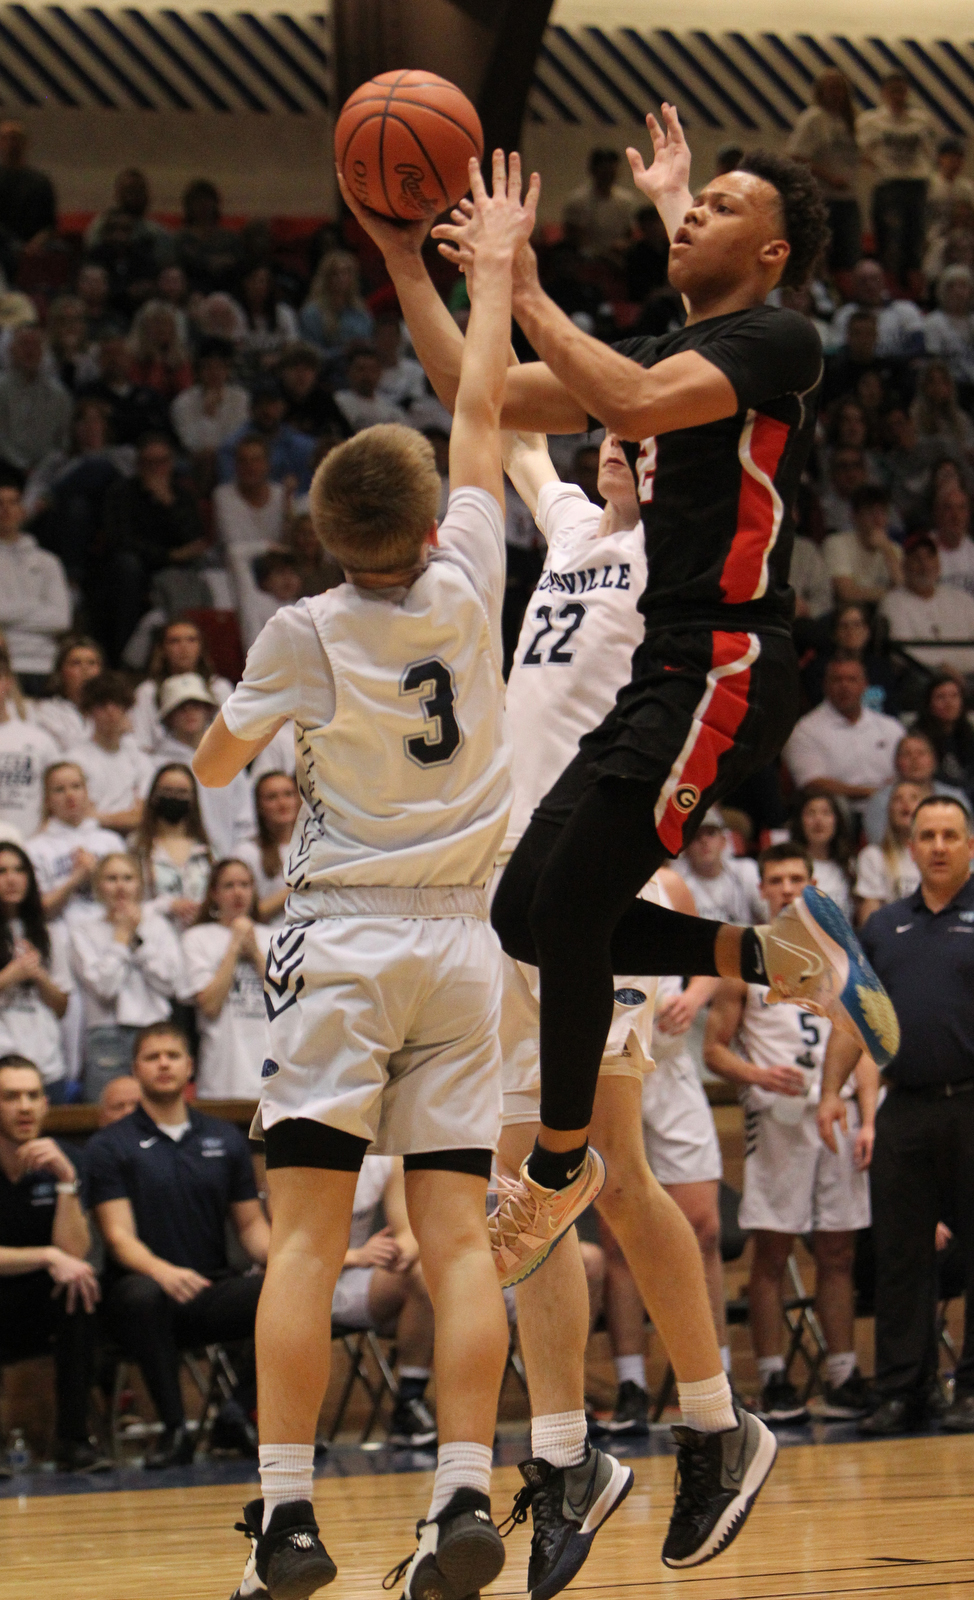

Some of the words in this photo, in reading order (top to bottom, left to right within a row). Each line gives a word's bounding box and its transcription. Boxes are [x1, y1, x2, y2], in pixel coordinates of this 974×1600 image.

[521, 600, 588, 668] 22
[399, 655, 464, 769] 3
[675, 786, 697, 810] G
[798, 1011, 819, 1047] 5
